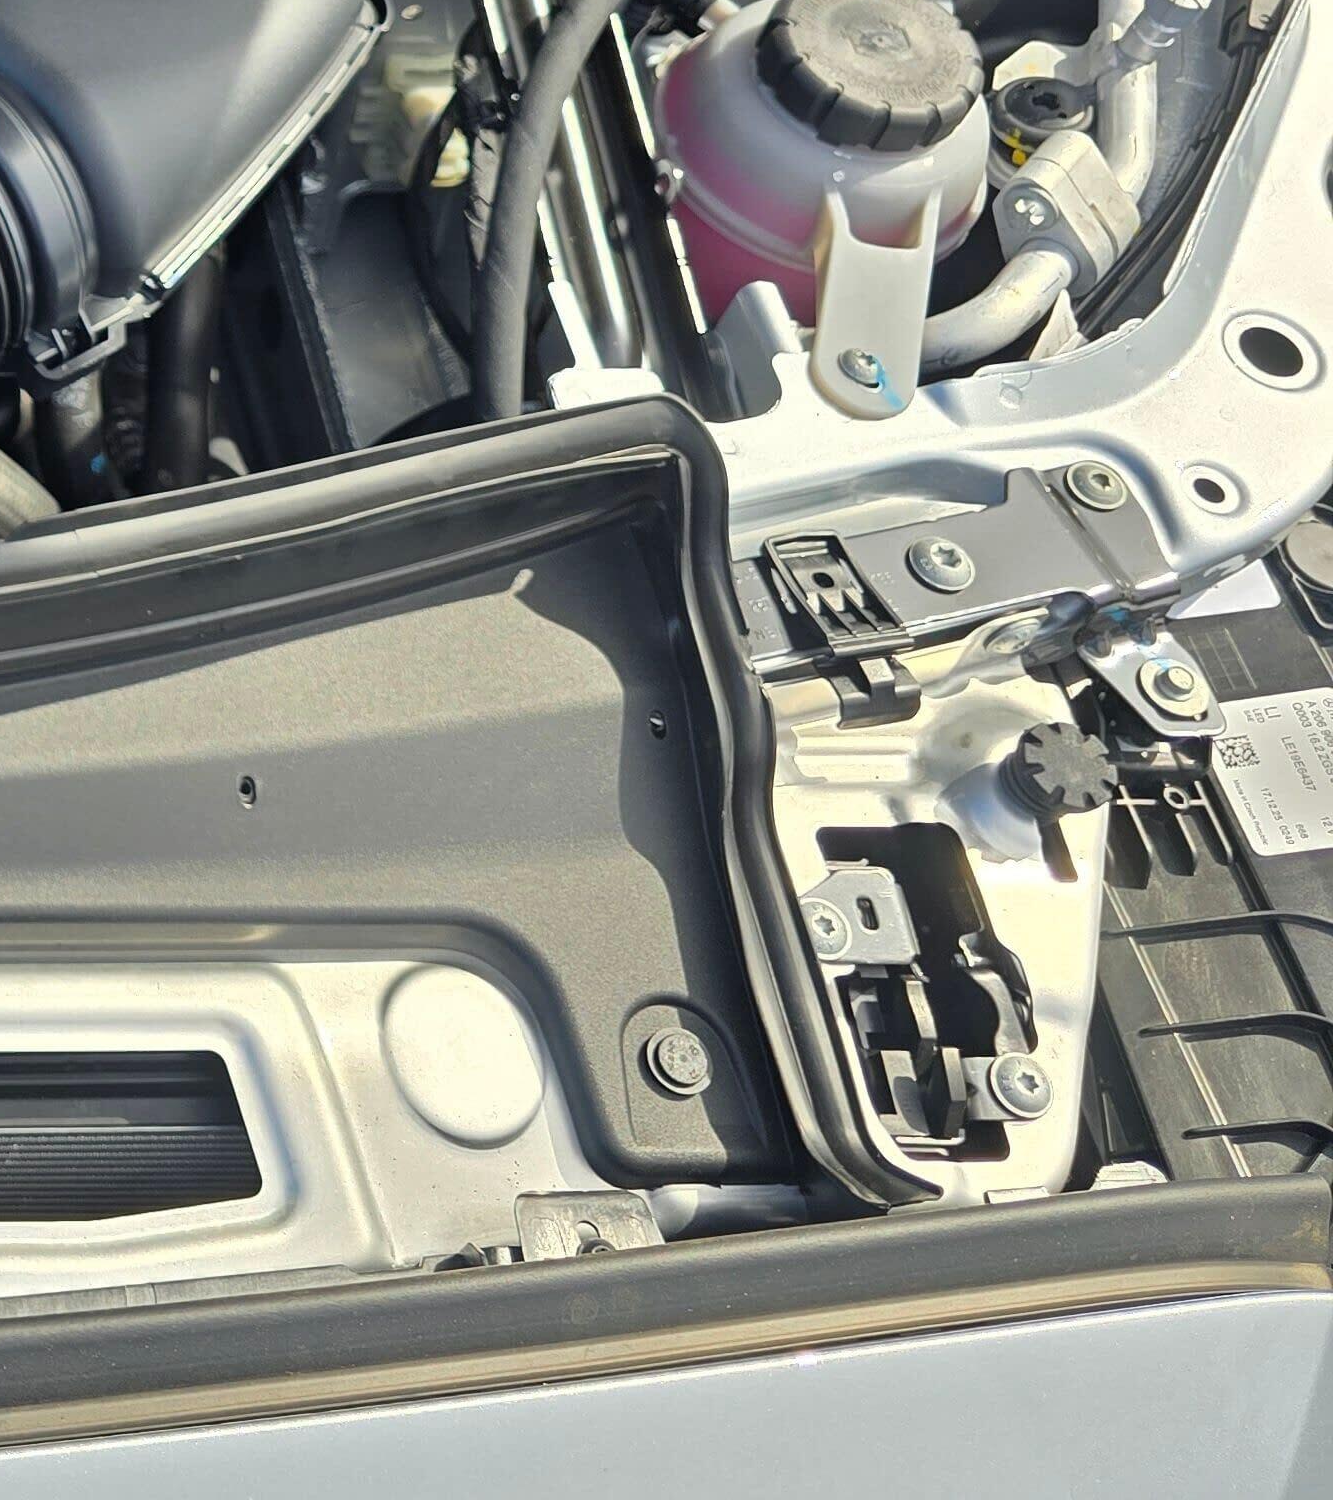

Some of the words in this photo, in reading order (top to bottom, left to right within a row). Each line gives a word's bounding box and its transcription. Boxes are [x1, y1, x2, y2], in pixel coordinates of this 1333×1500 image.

[1305, 700, 1317, 709] A
[1252, 708, 1265, 724] LED
[1310, 709, 1328, 728] 206
